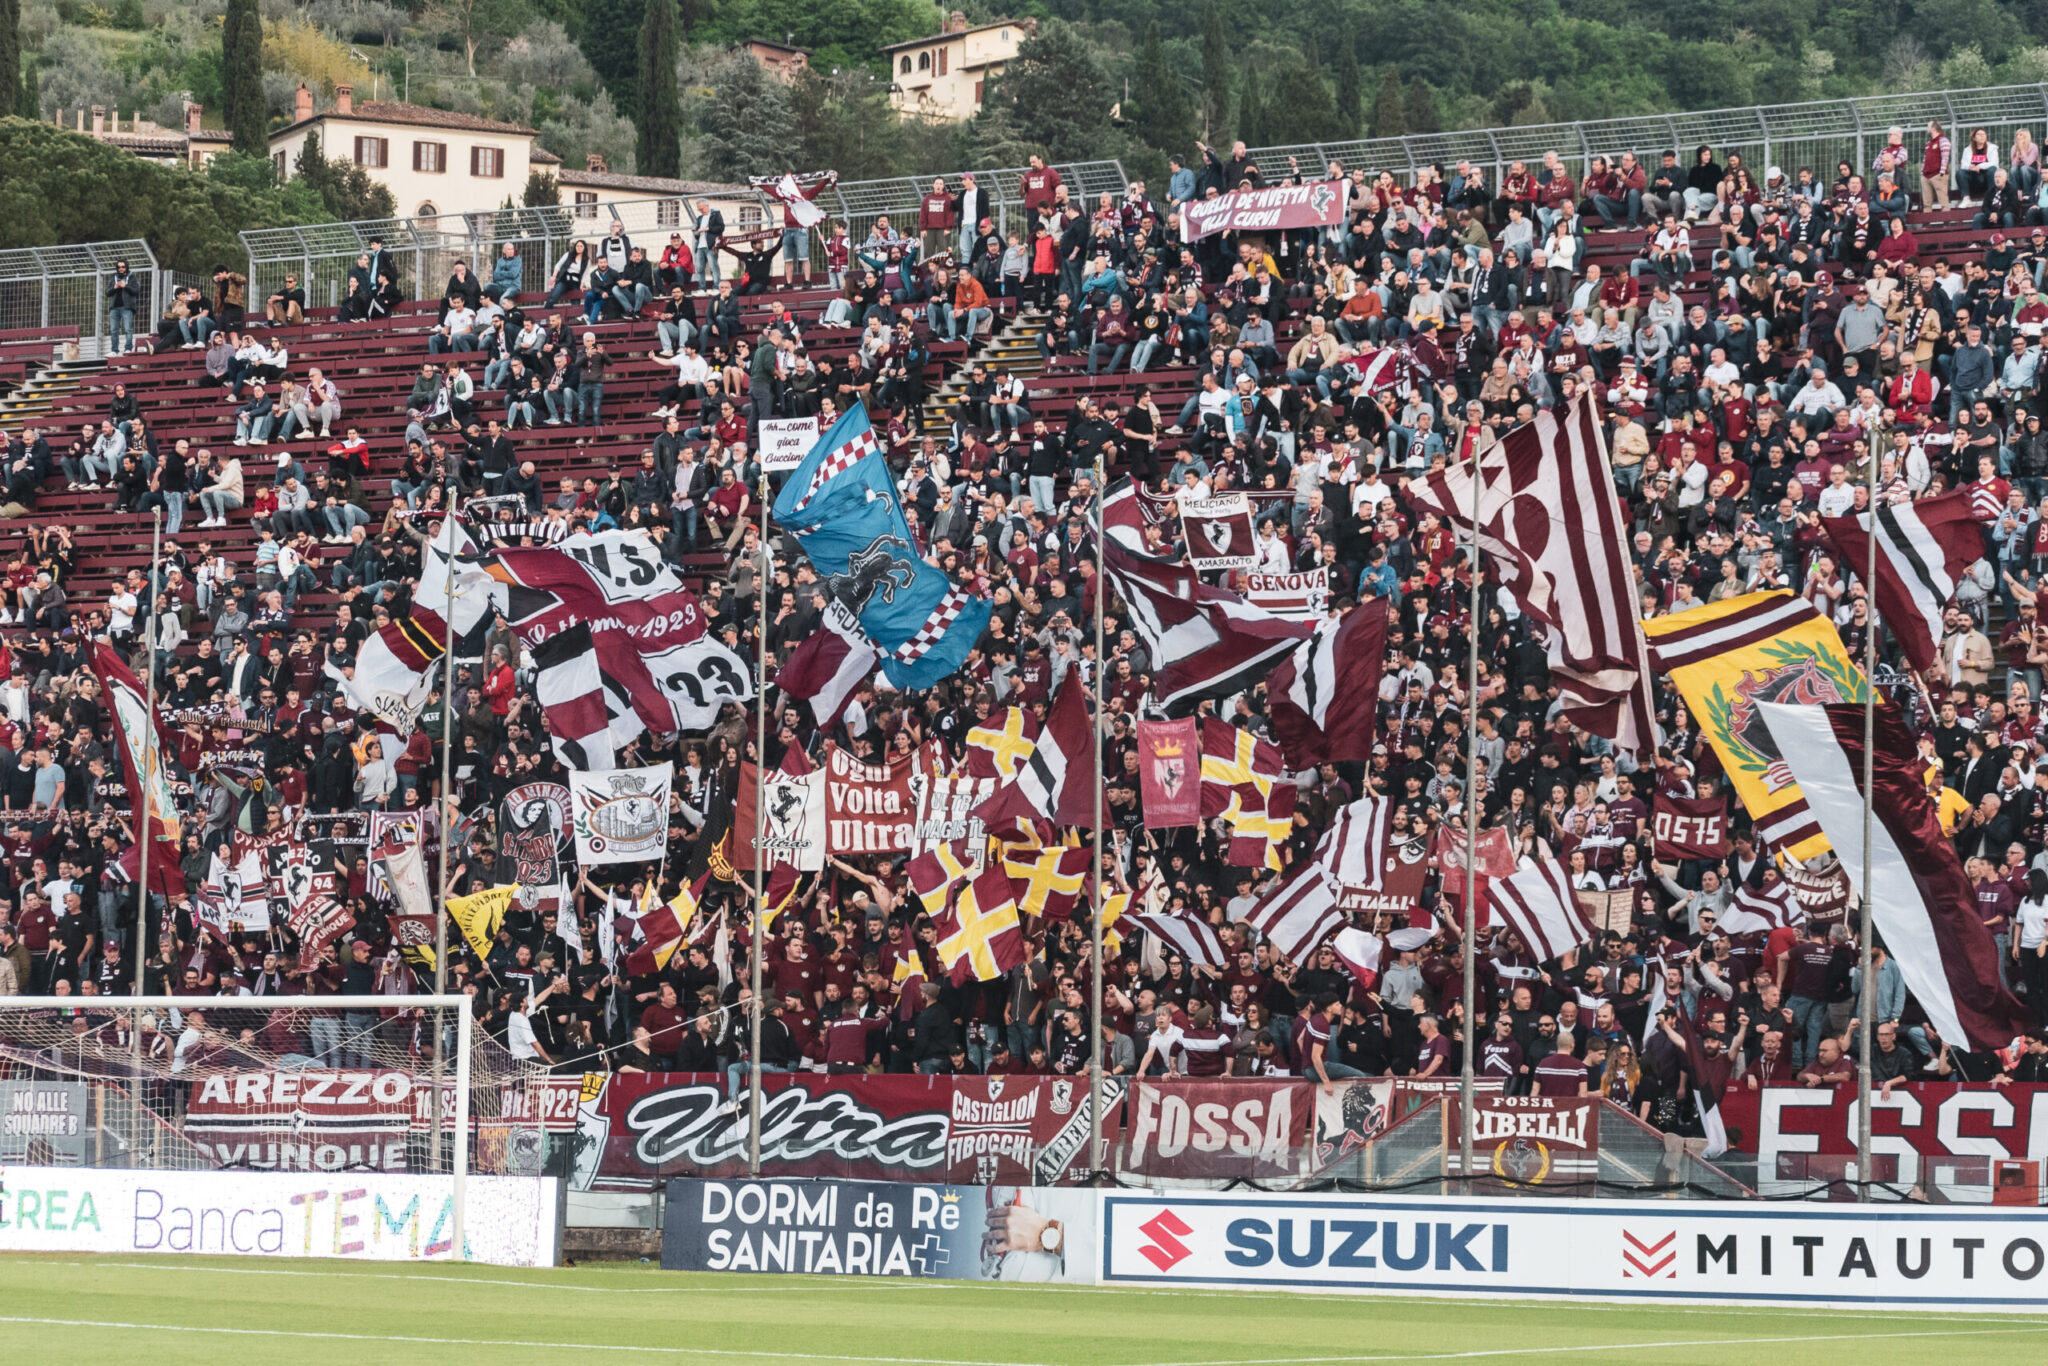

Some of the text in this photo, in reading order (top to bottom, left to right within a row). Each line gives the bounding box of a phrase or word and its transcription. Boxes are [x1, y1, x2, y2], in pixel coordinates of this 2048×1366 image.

[1233, 209, 1283, 228] CURVA
[777, 437, 800, 448] gioca
[1198, 557, 1253, 568] AMARANTO
[1247, 573, 1328, 592] GENOVA
[641, 603, 697, 639] 1923
[831, 748, 892, 783] Ogni
[829, 781, 909, 815] Volta,
[829, 819, 917, 851] Ultra
[1655, 811, 1721, 845] 0575
[275, 849, 322, 870] AREZZO
[313, 876, 334, 891] 94
[14, 1091, 68, 1112] NO ALLE
[199, 1072, 412, 1104] AREZZO
[1407, 1081, 1443, 1091] FOSSA
[1493, 1096, 1555, 1108] FOSSA
[952, 1085, 1040, 1124] CASTIGLION
[68, 1114, 78, 1135] B
[625, 1085, 951, 1169] Ultra
[1129, 1082, 1294, 1171] FOSSA
[947, 1133, 1034, 1171] FIBOCCHI
[702, 1183, 838, 1226] DORMI
[853, 1192, 894, 1228] da
[707, 1229, 912, 1275] SANITARIA
[1224, 1217, 1508, 1273] SUZUKI
